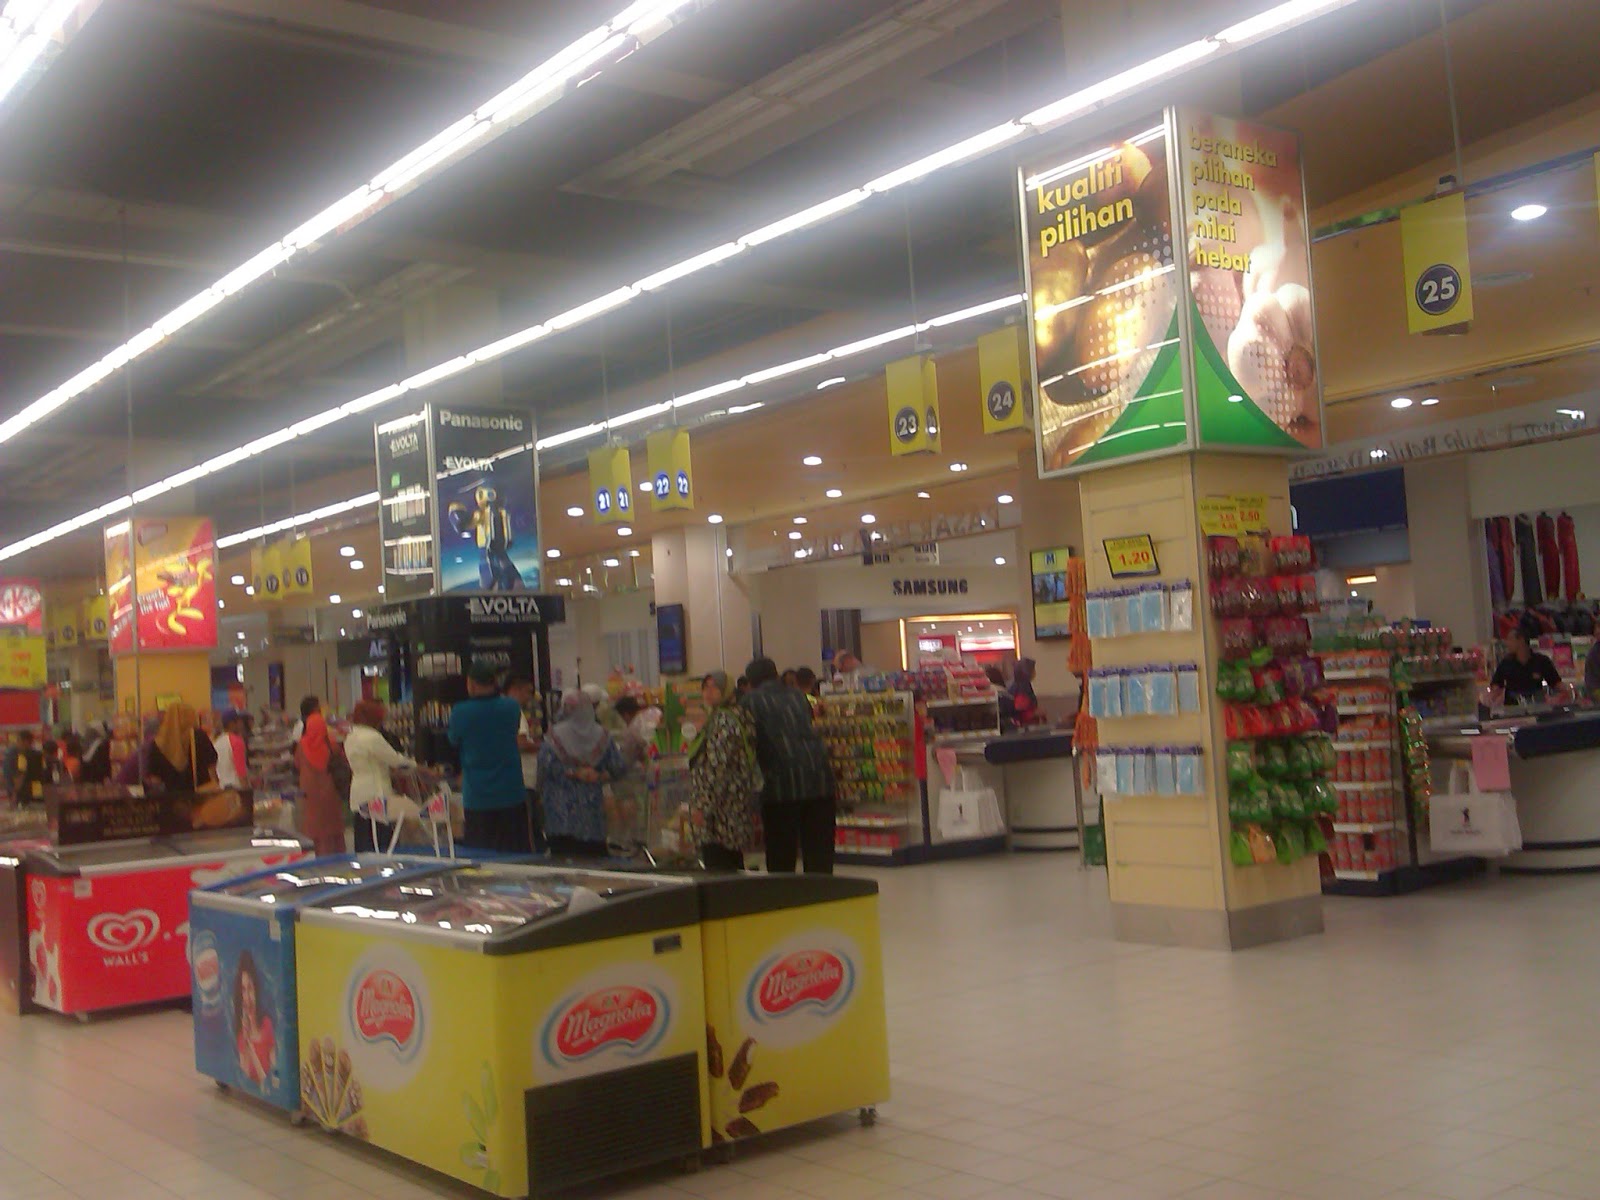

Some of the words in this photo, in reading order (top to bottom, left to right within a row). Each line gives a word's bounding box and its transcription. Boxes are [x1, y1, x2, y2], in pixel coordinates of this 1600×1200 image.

[1190, 126, 1278, 168] beraneka
[1037, 153, 1124, 214] kualiti
[1191, 155, 1256, 191] pilihan
[1192, 190, 1243, 215] pada
[1040, 197, 1134, 257] pilihan
[1194, 214, 1237, 243] nilai
[1196, 242, 1251, 273] hebat
[1422, 276, 1456, 304] 25
[992, 390, 1014, 412] 24
[439, 409, 524, 432] Panasonic
[898, 415, 917, 436] 23
[442, 455, 495, 473] EVOLTA
[656, 477, 670, 495] 22
[677, 476, 689, 494] 22
[598, 492, 611, 510] 21
[618, 491, 629, 508] 21
[1117, 551, 1150, 566] 1.20
[893, 578, 968, 595] SAMSUNG
[465, 597, 541, 615] EVOLTA
[563, 1000, 652, 1045] Magnolia
